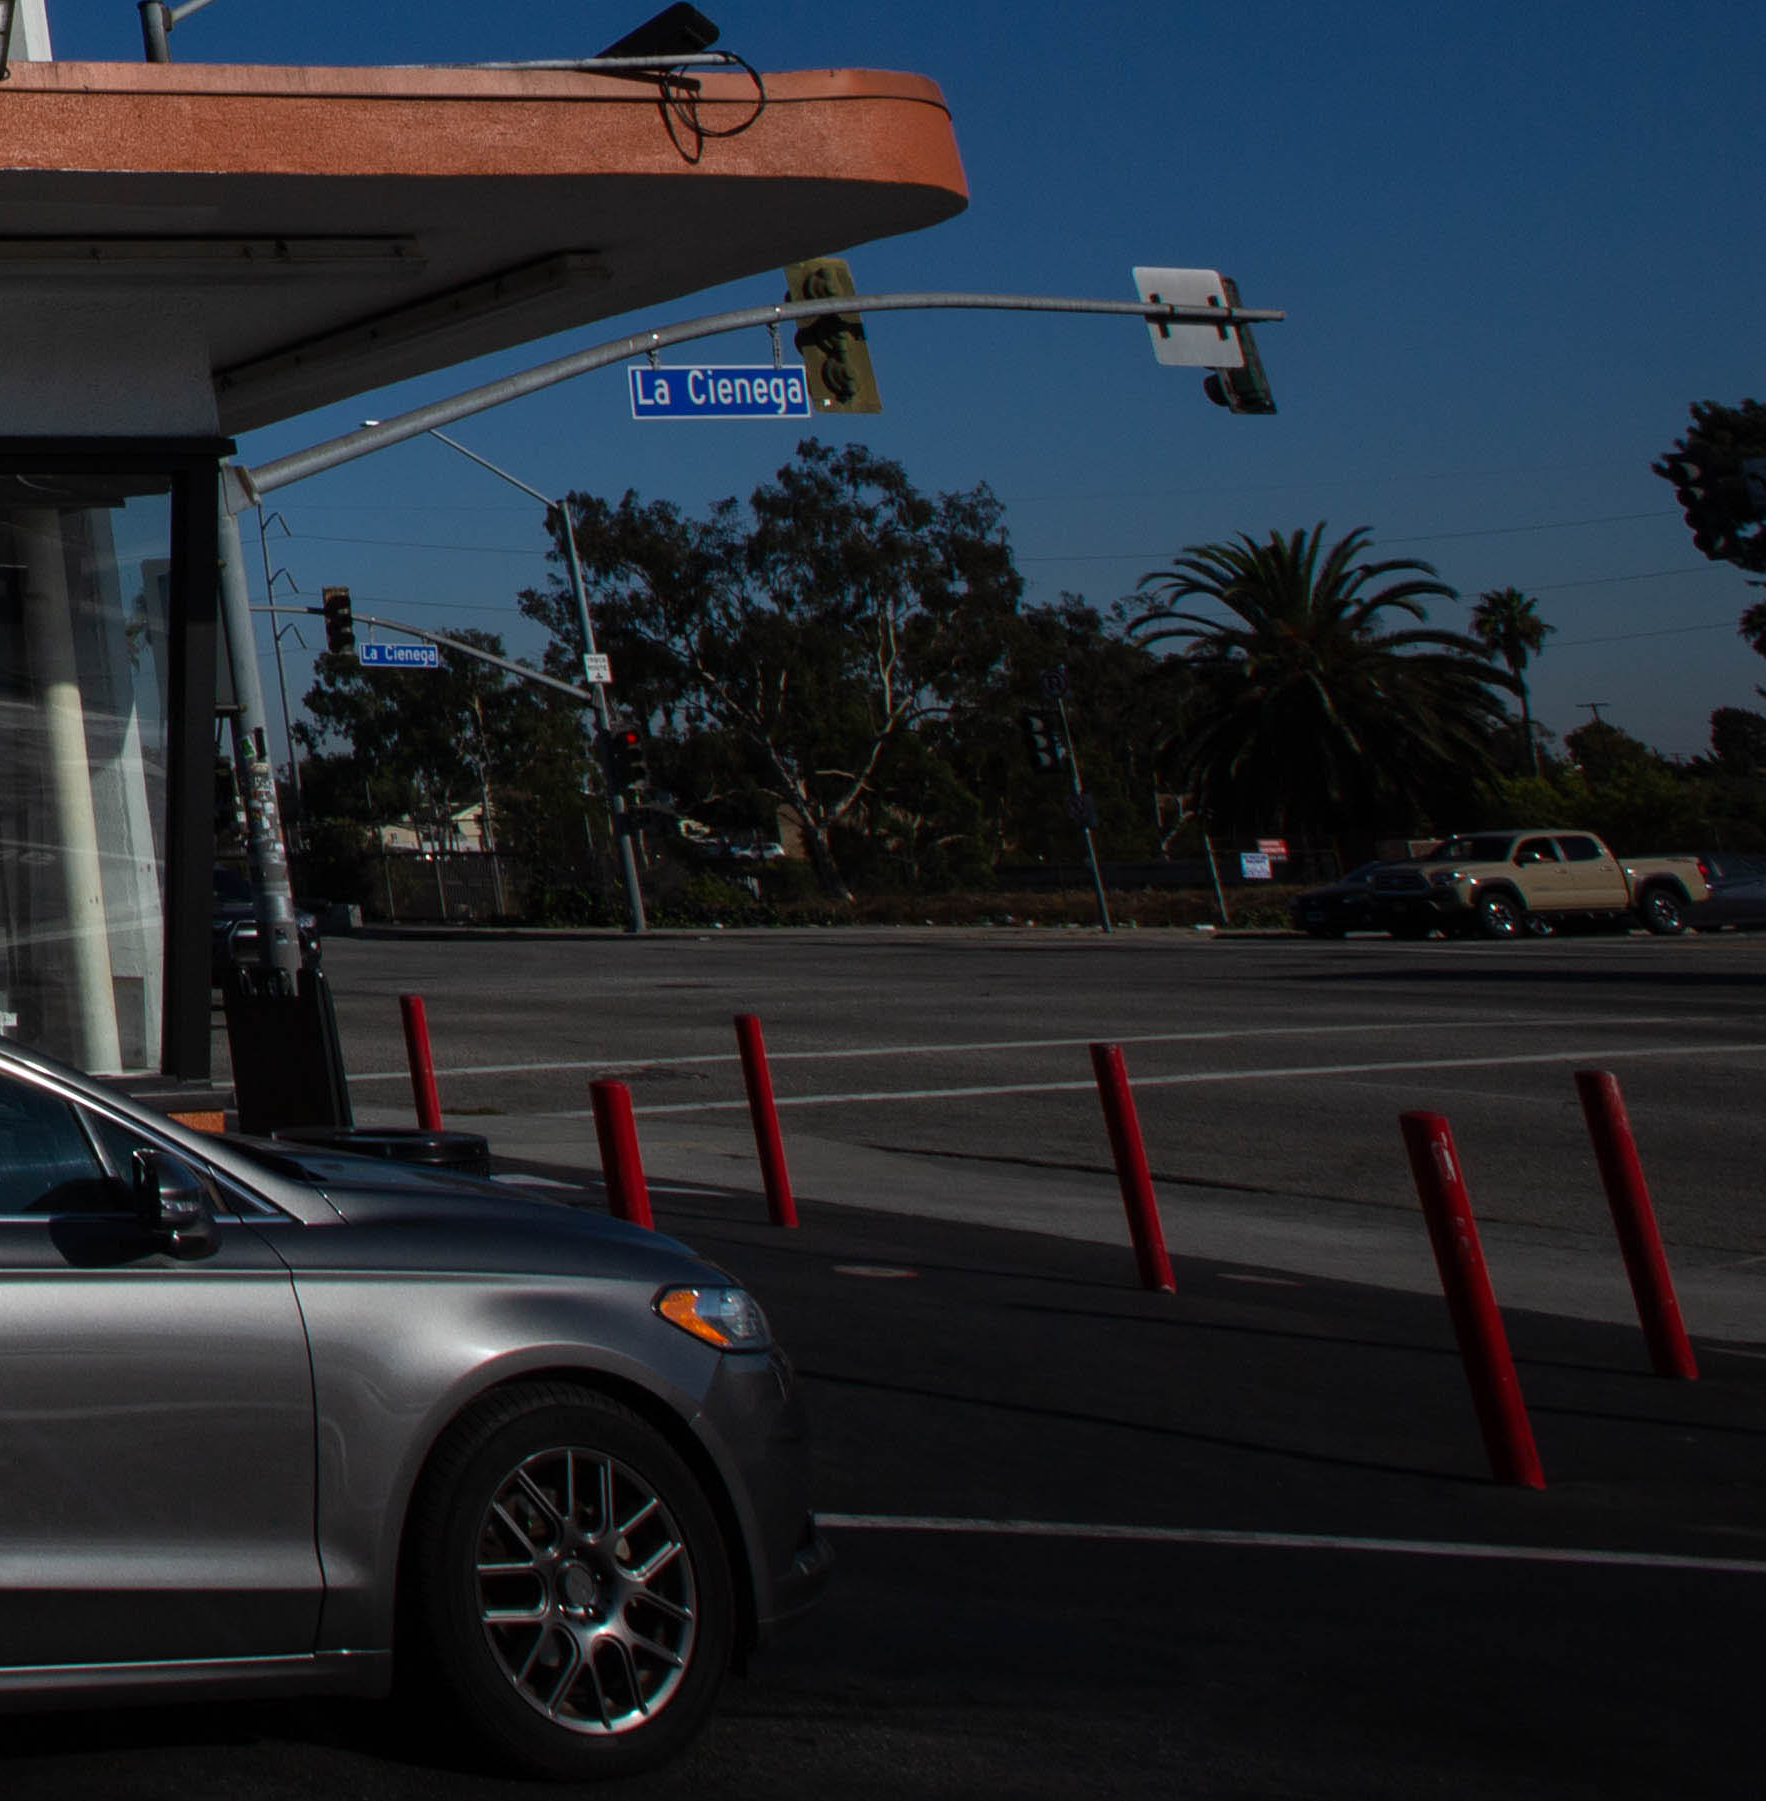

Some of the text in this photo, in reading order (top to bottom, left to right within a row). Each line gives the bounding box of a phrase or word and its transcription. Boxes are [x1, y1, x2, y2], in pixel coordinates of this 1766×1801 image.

[636, 369, 803, 415] La Cienega
[363, 646, 436, 666] La Cienega
